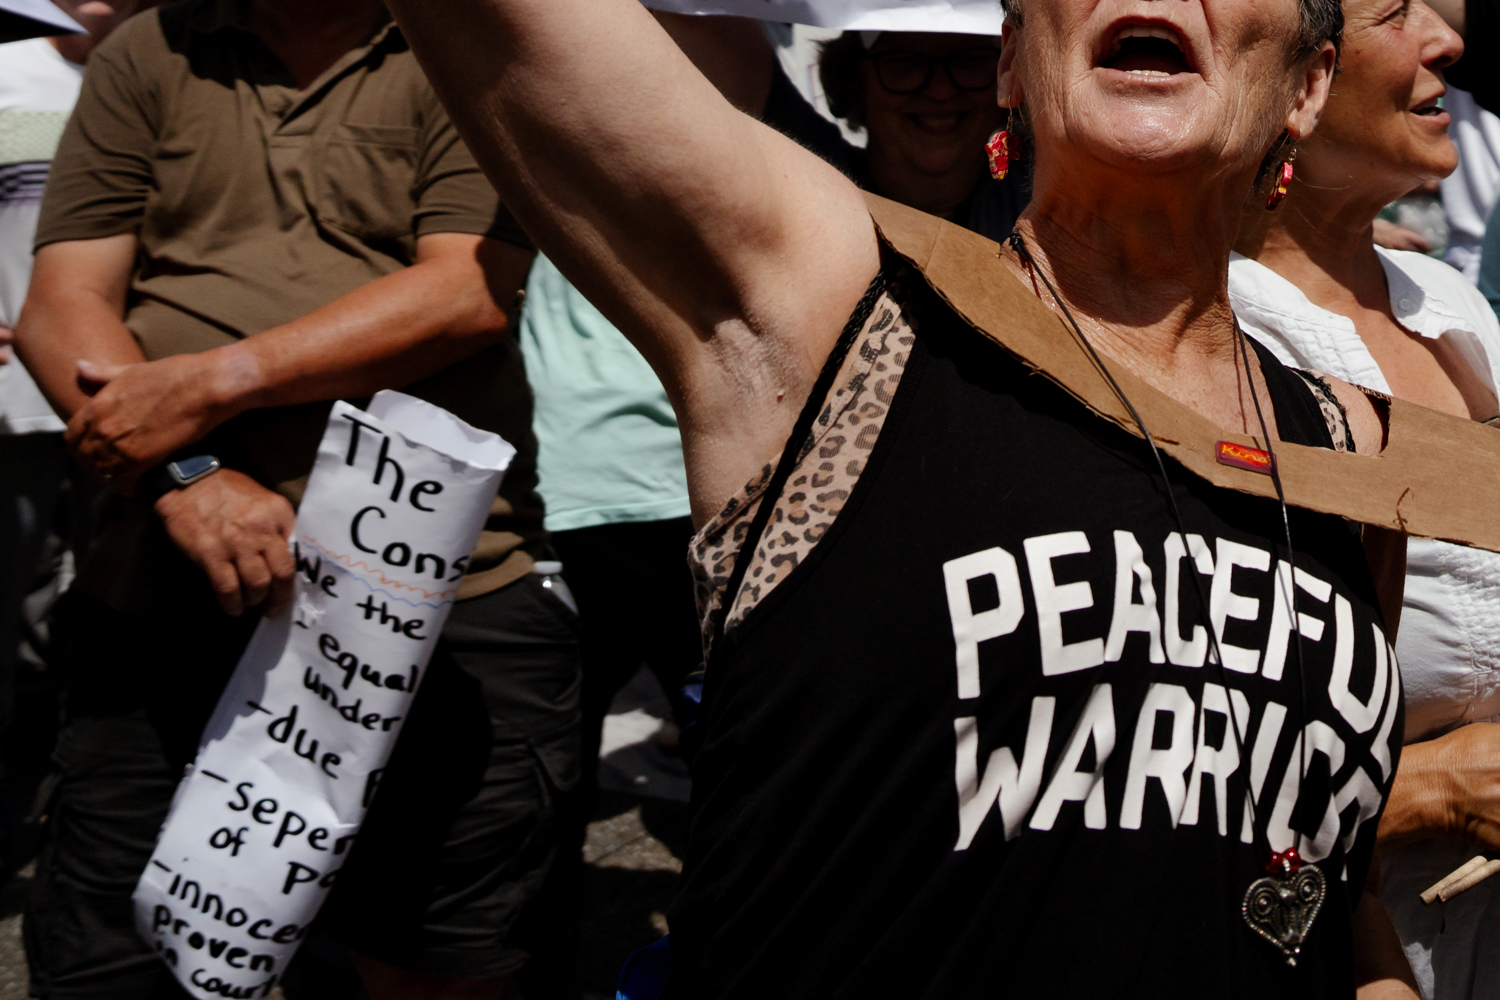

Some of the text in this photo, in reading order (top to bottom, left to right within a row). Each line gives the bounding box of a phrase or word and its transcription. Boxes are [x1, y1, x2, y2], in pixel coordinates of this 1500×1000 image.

[341, 413, 444, 512] The
[350, 504, 471, 583] Cons
[293, 541, 428, 641] We the
[303, 665, 402, 732] under
